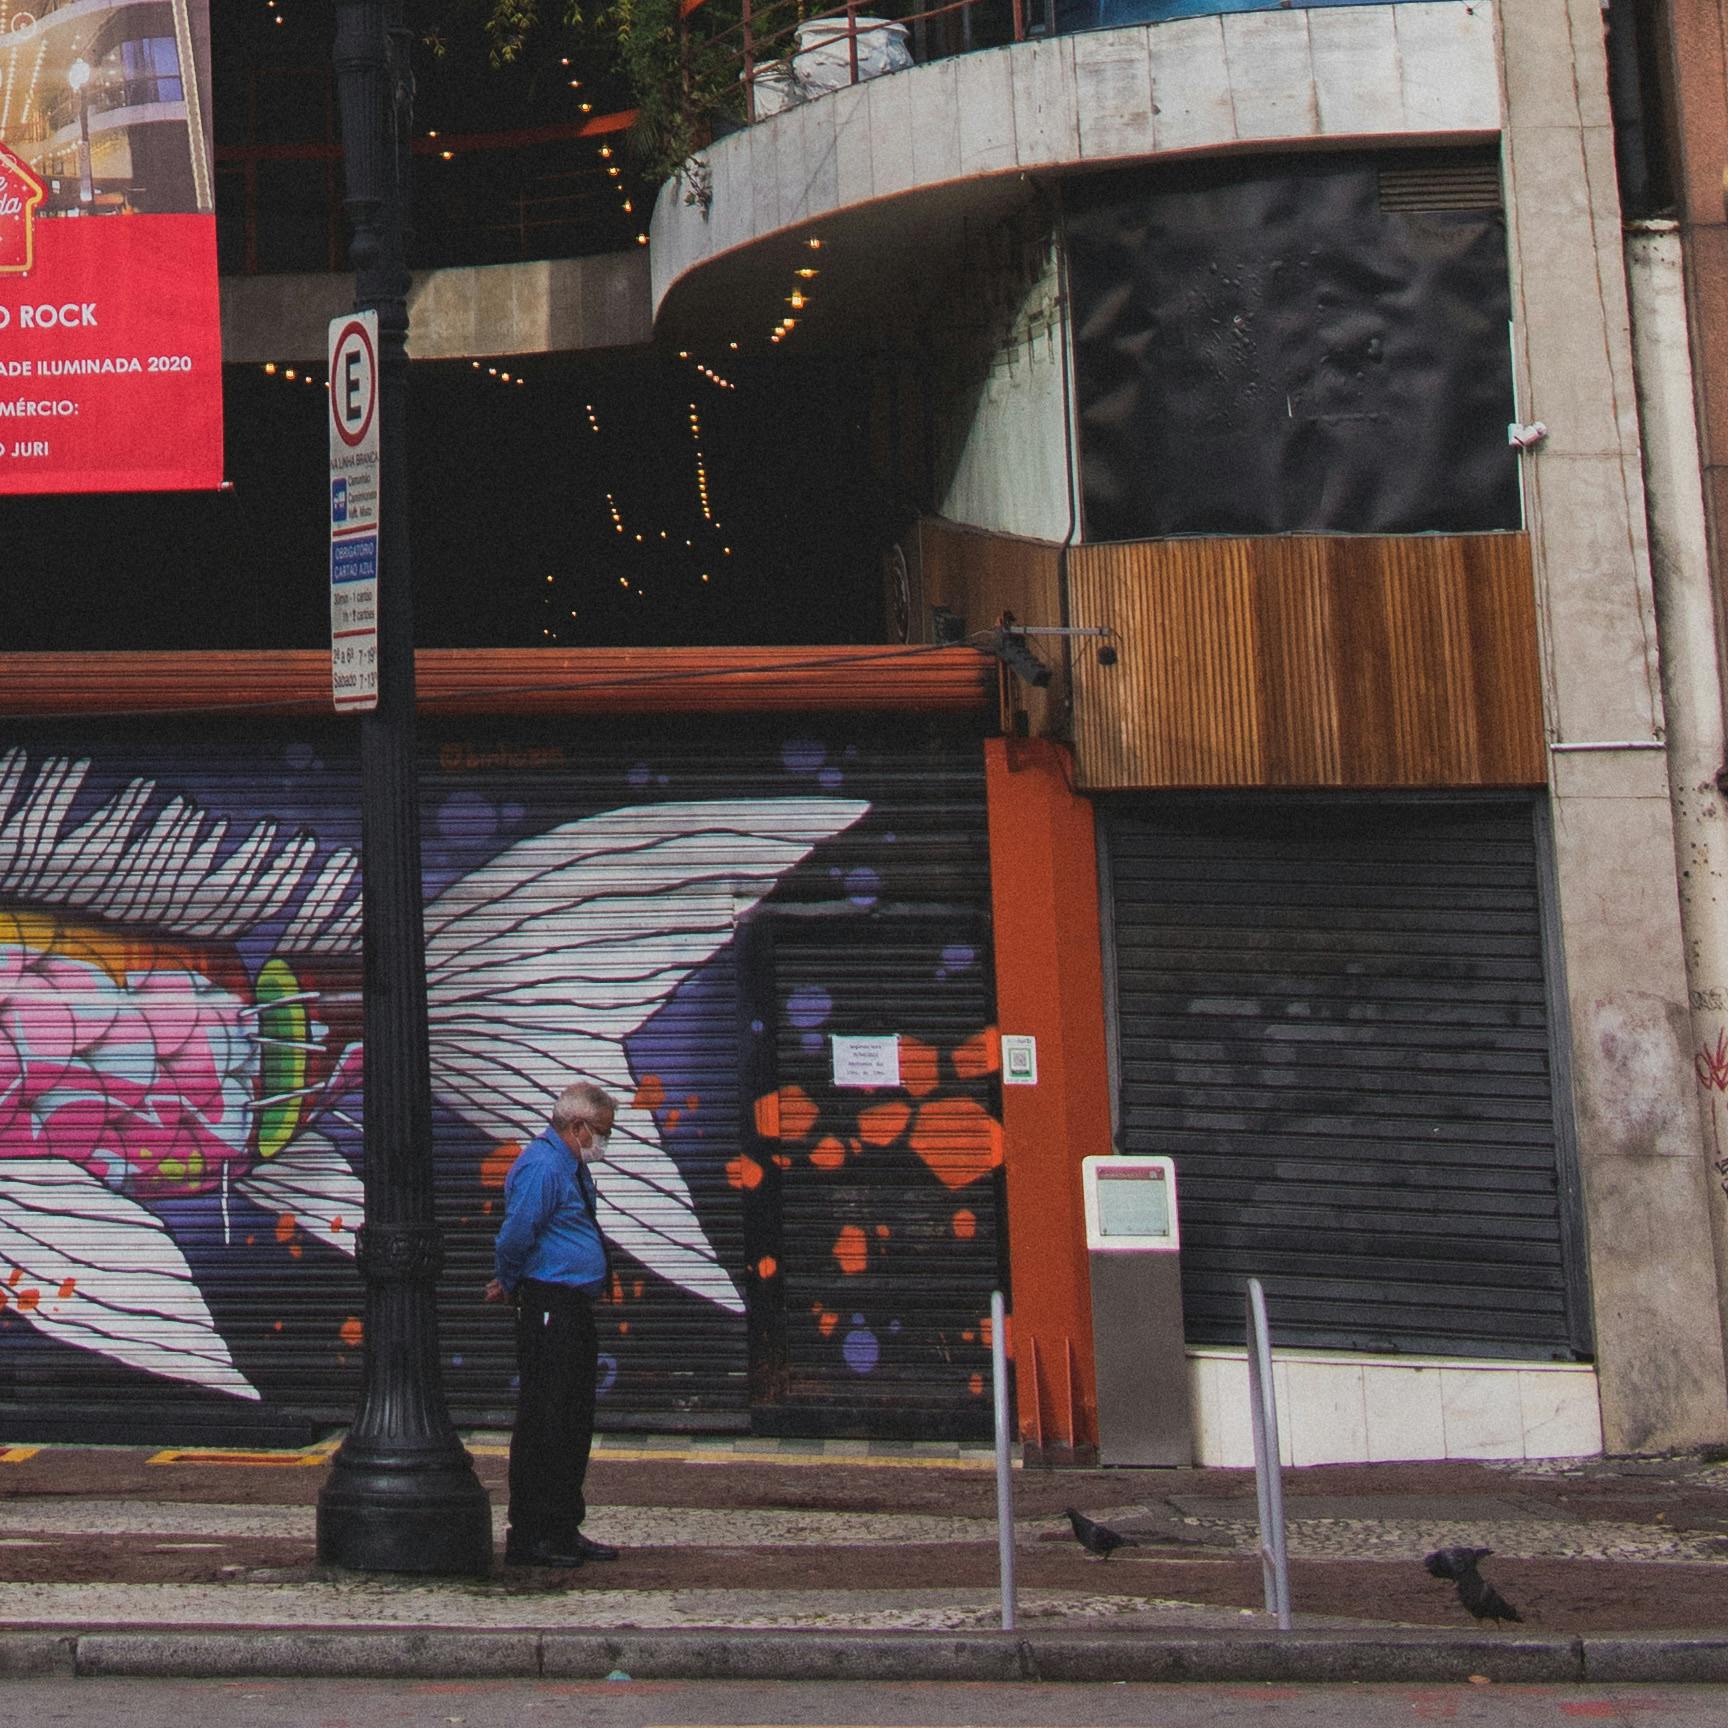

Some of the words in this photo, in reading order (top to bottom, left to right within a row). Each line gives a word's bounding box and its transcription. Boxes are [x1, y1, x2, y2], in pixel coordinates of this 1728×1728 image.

[20, 302, 99, 329] ROCK
[37, 357, 143, 377] ILUMINADA
[147, 355, 192, 373] 2020
[345, 348, 363, 423] E
[10, 440, 50, 458] JURI
[359, 560, 375, 576] AZUL
